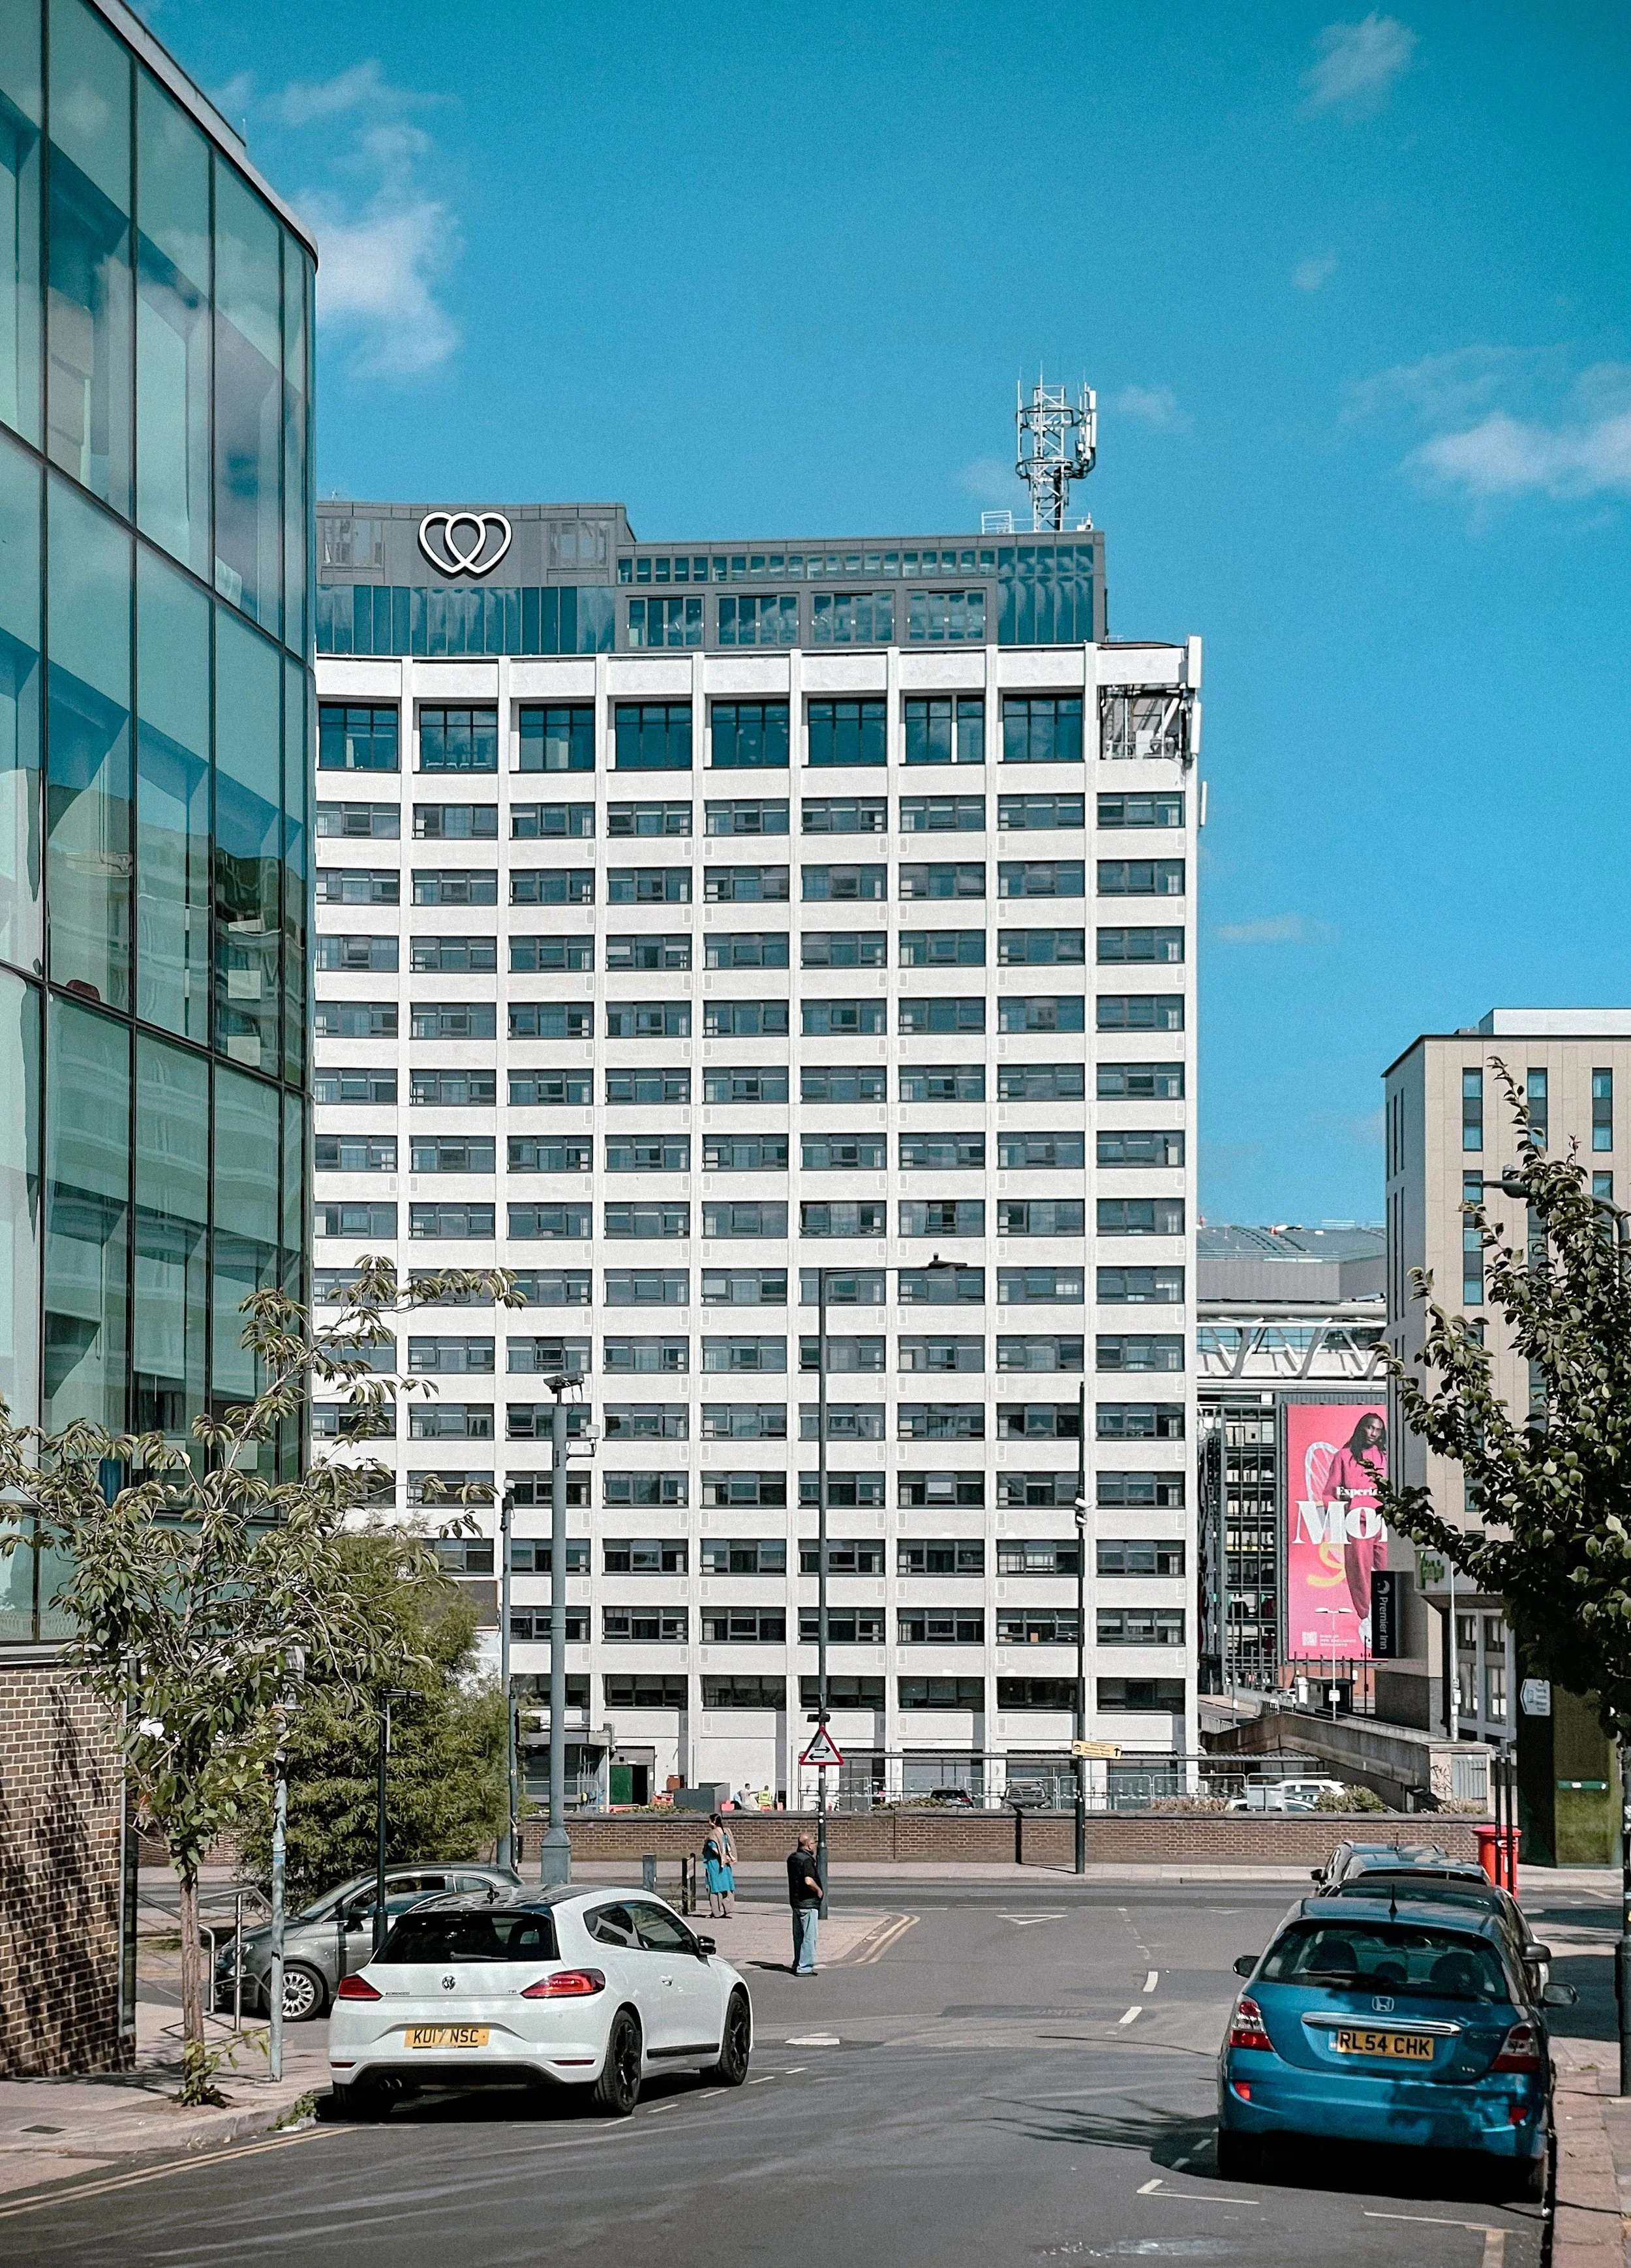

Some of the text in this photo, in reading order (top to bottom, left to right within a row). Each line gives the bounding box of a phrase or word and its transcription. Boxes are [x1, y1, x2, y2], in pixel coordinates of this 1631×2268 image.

[1379, 1597, 1389, 1650] Premier Inn
[414, 2029, 479, 2044] KU17 NSC
[1340, 2031, 1430, 2056] RL54 CHK
